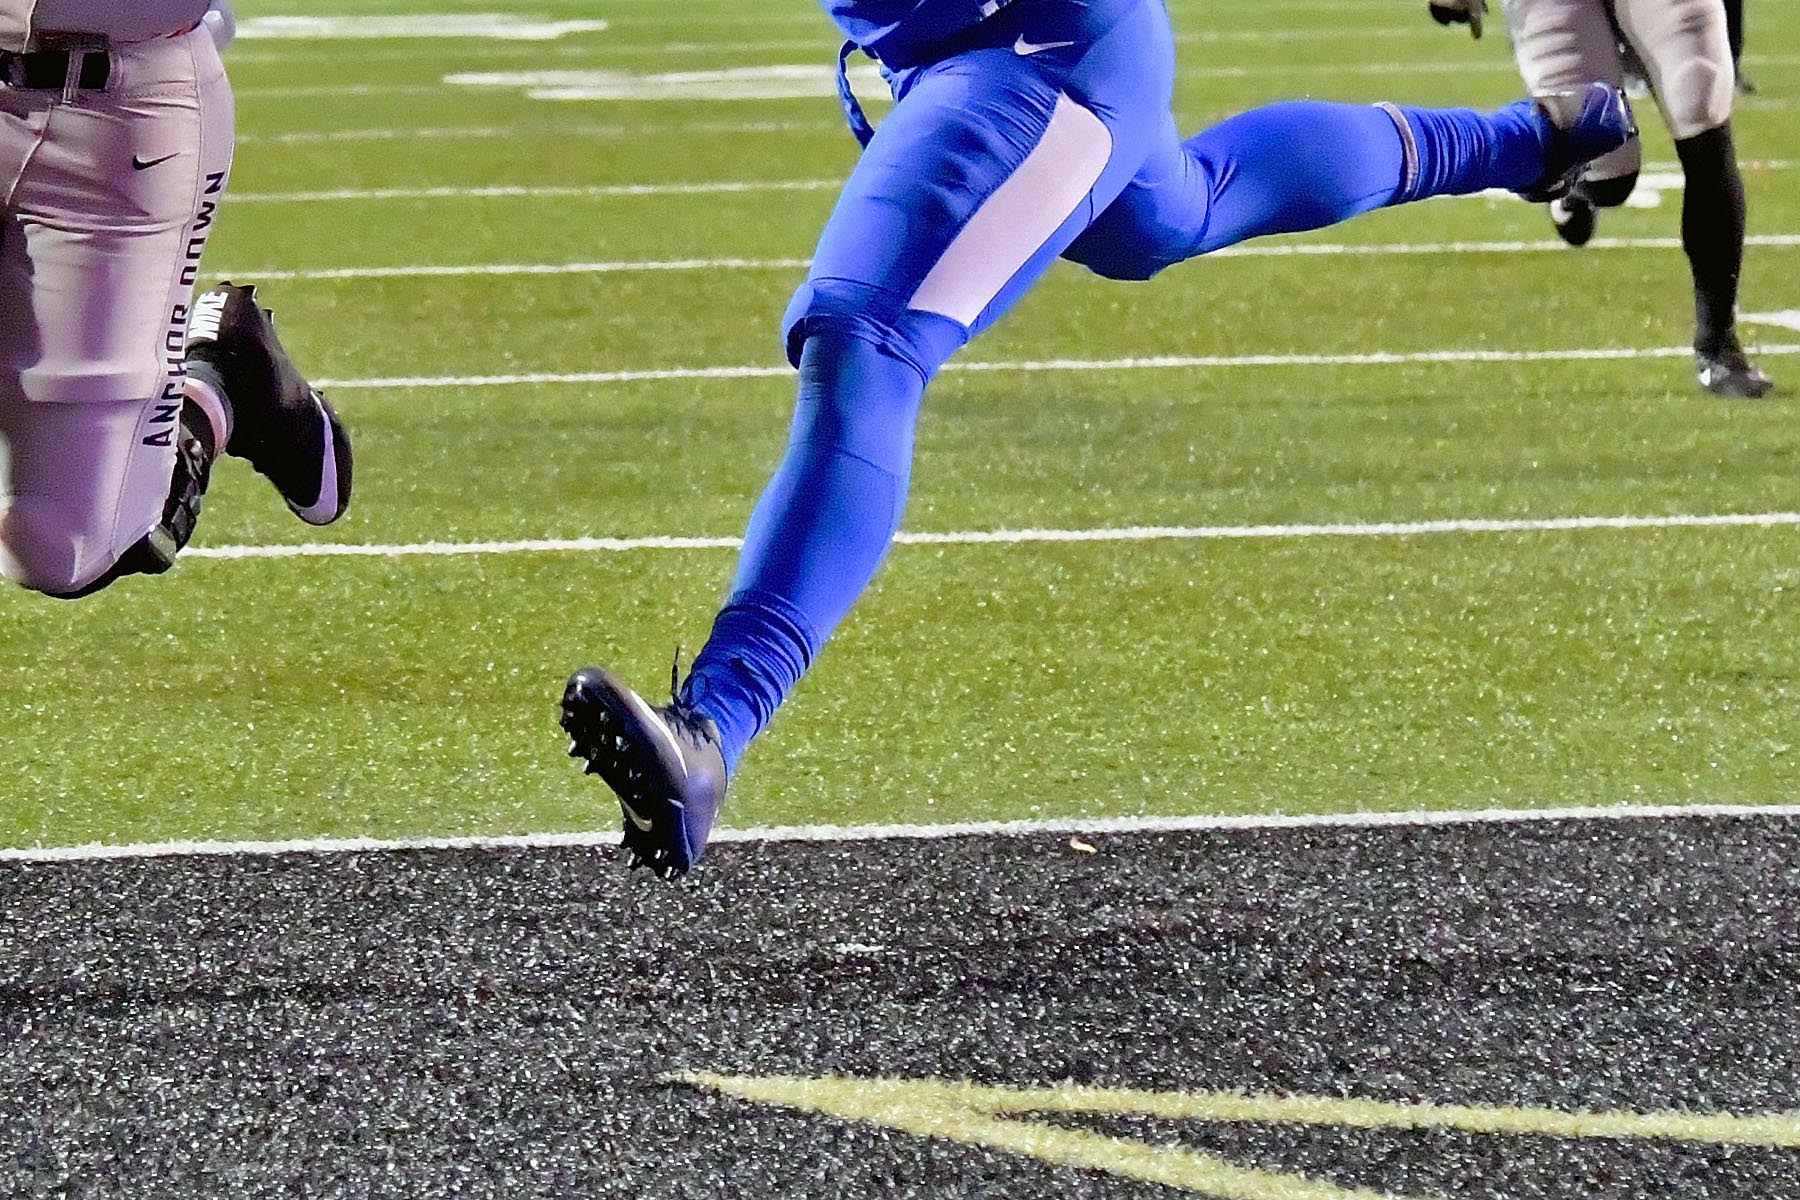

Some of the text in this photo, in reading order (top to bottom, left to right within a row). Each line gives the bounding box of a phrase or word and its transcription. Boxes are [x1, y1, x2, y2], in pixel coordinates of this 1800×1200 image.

[142, 171, 226, 447] ANCHOR DOWN
[188, 291, 229, 341] NIKE
